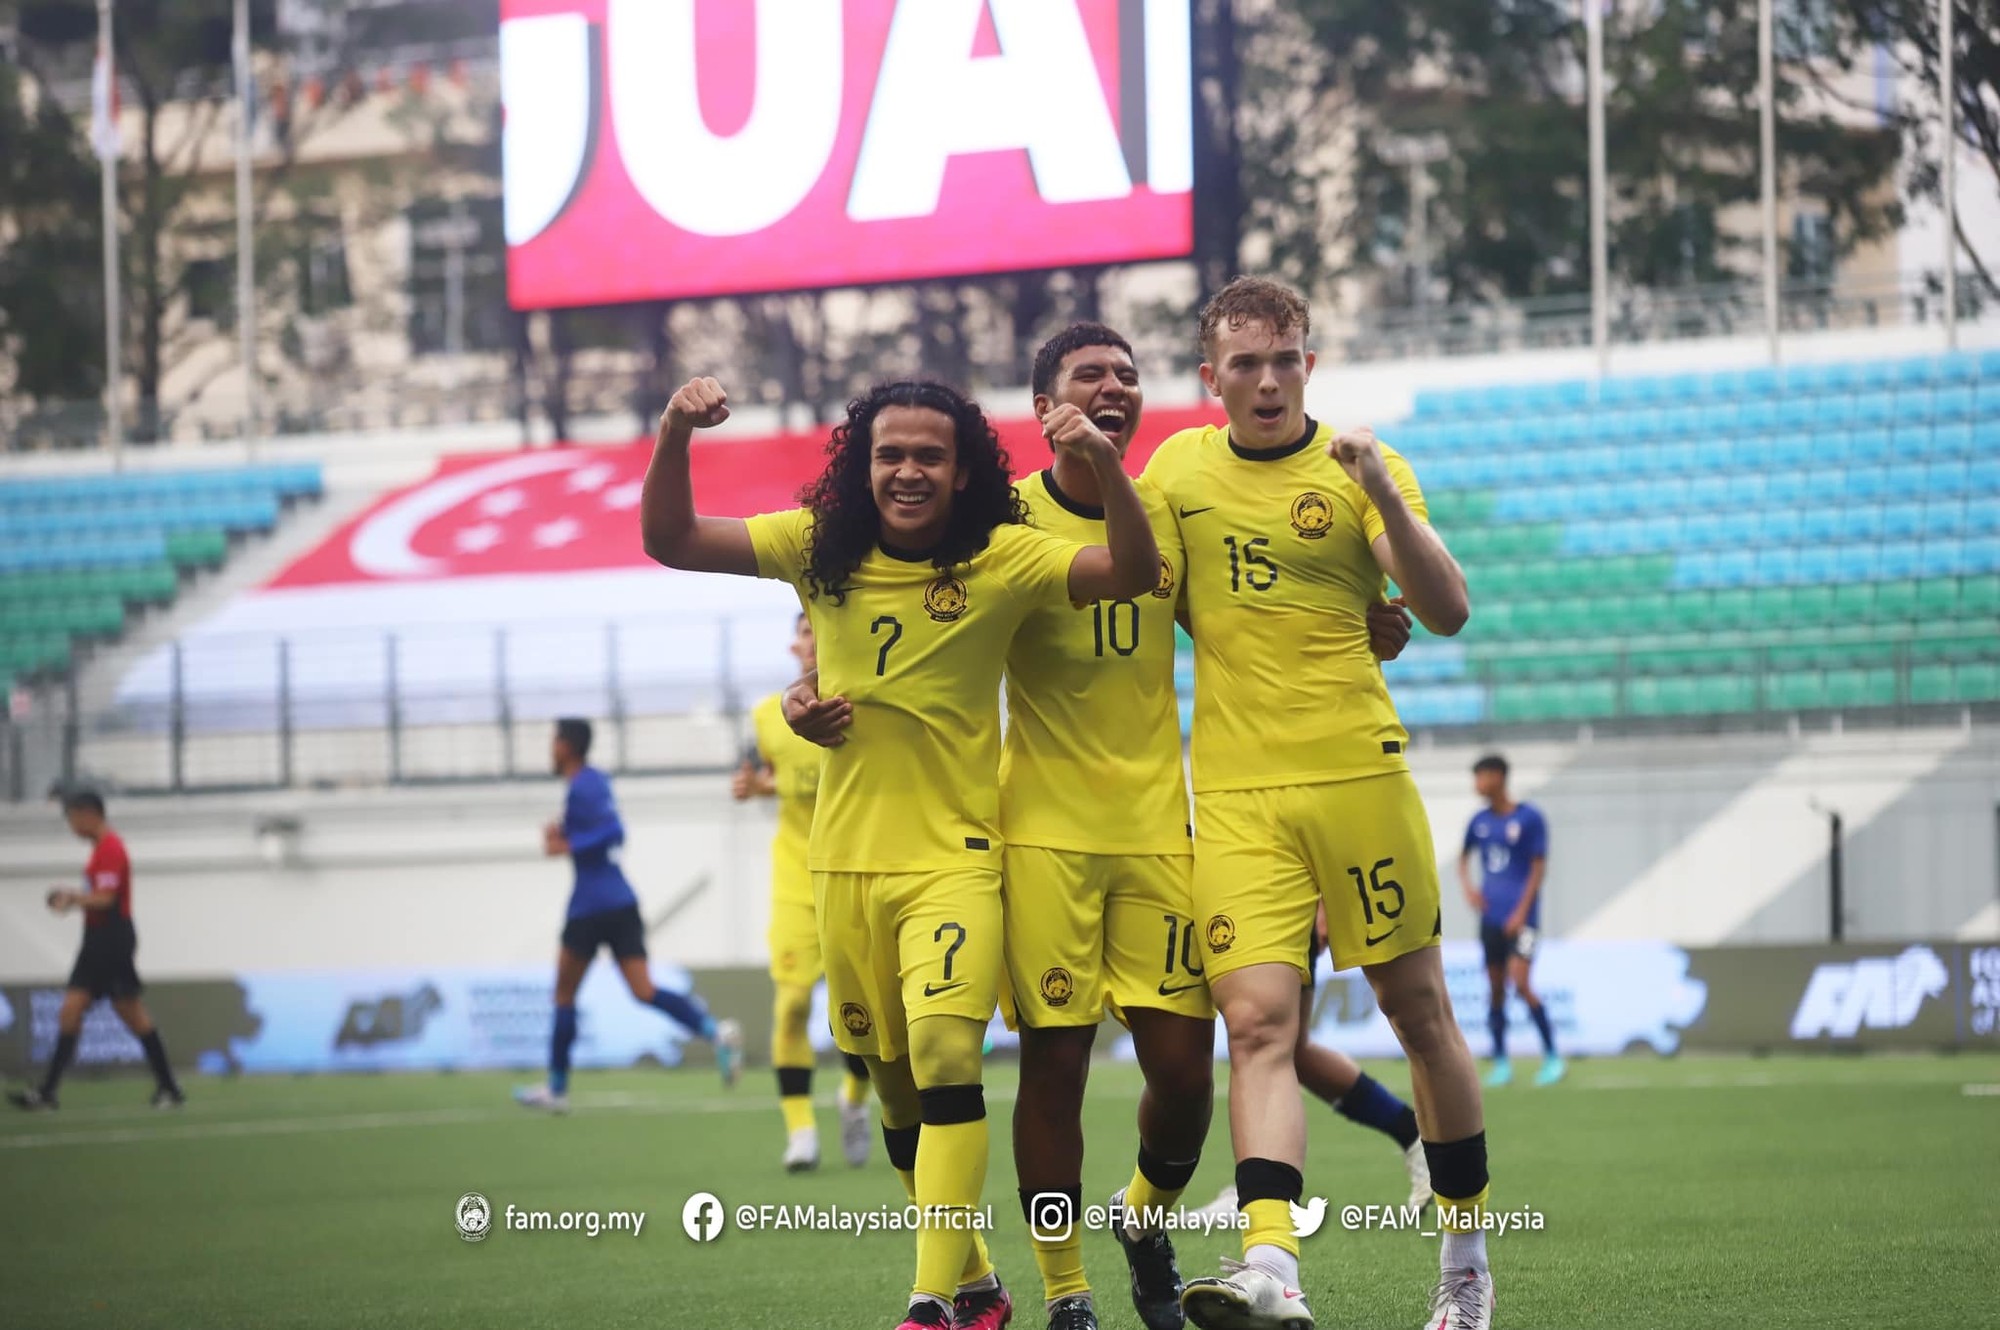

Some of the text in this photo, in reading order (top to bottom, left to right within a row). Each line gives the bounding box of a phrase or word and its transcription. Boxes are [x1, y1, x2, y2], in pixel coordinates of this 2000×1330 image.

[1223, 535, 1279, 593] 15
[870, 615, 903, 677] 7
[1090, 599, 1140, 657] 10
[1347, 857, 1406, 926] 15
[933, 921, 967, 980] 7
